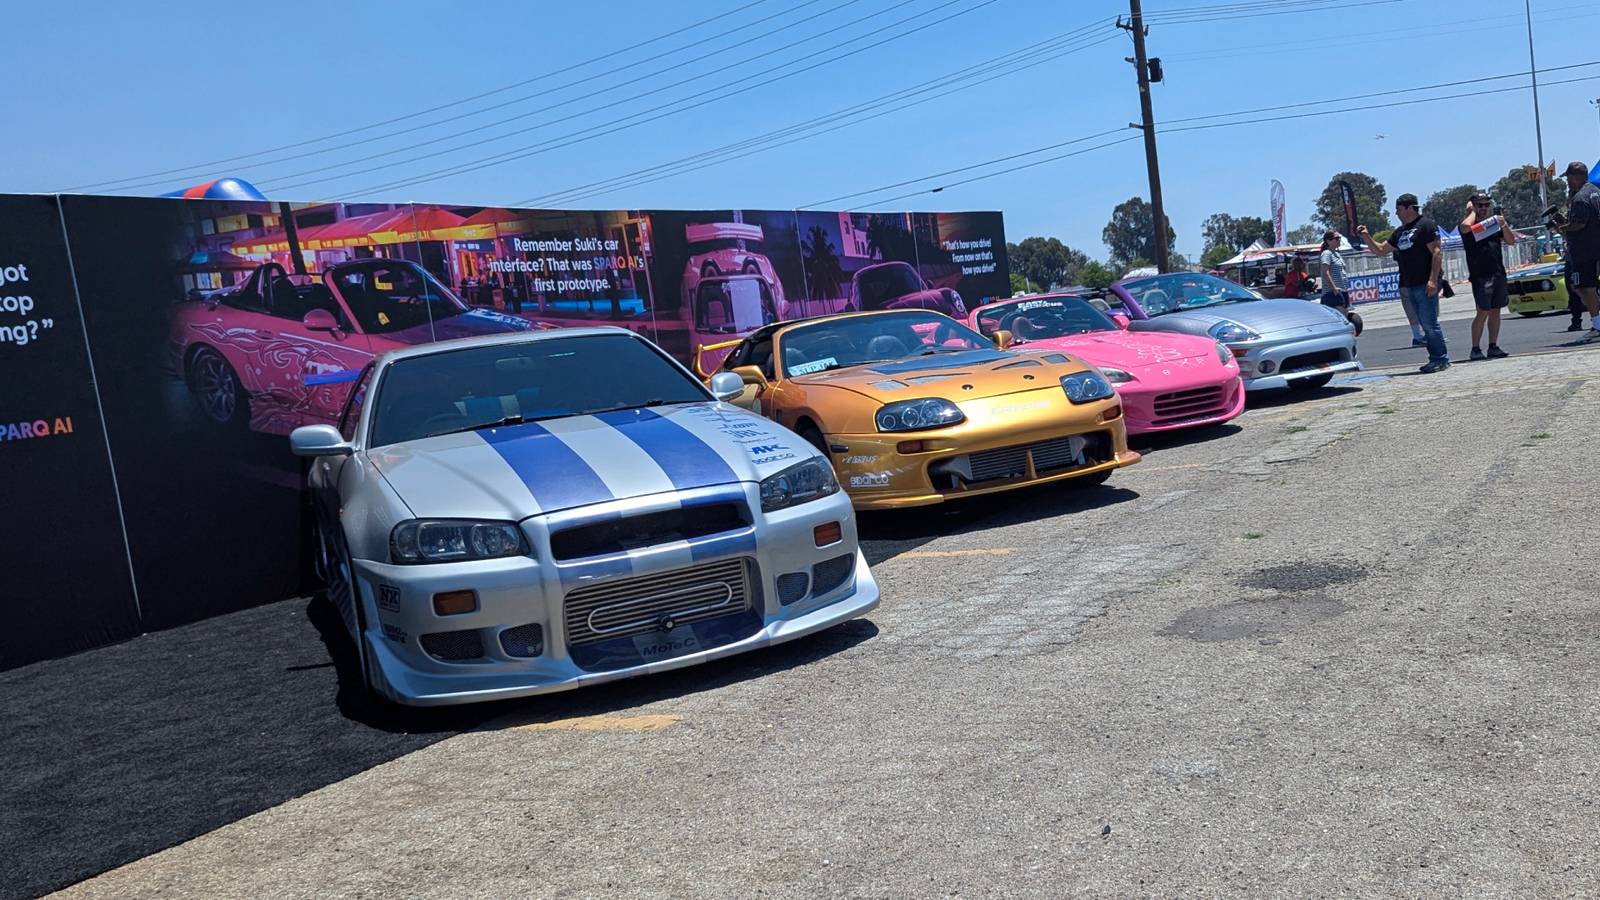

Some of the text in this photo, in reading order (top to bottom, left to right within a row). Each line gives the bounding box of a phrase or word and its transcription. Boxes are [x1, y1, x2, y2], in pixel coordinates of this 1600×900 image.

[514, 237, 619, 252] Remember Suki's car
[959, 239, 970, 249] how
[970, 241, 979, 250] you
[489, 257, 544, 272] interface?
[546, 257, 570, 271] That
[571, 260, 592, 270] was
[593, 256, 625, 270] SPARQ
[952, 253, 964, 263] From
[962, 265, 972, 275] how
[973, 266, 981, 276] you
[534, 278, 611, 294] first prototype.
[1348, 278, 1376, 290] IQUI
[1379, 285, 1386, 293] &
[1379, 291, 1395, 299] MADE
[54, 416, 73, 434] AI
[850, 473, 889, 487] sparco
